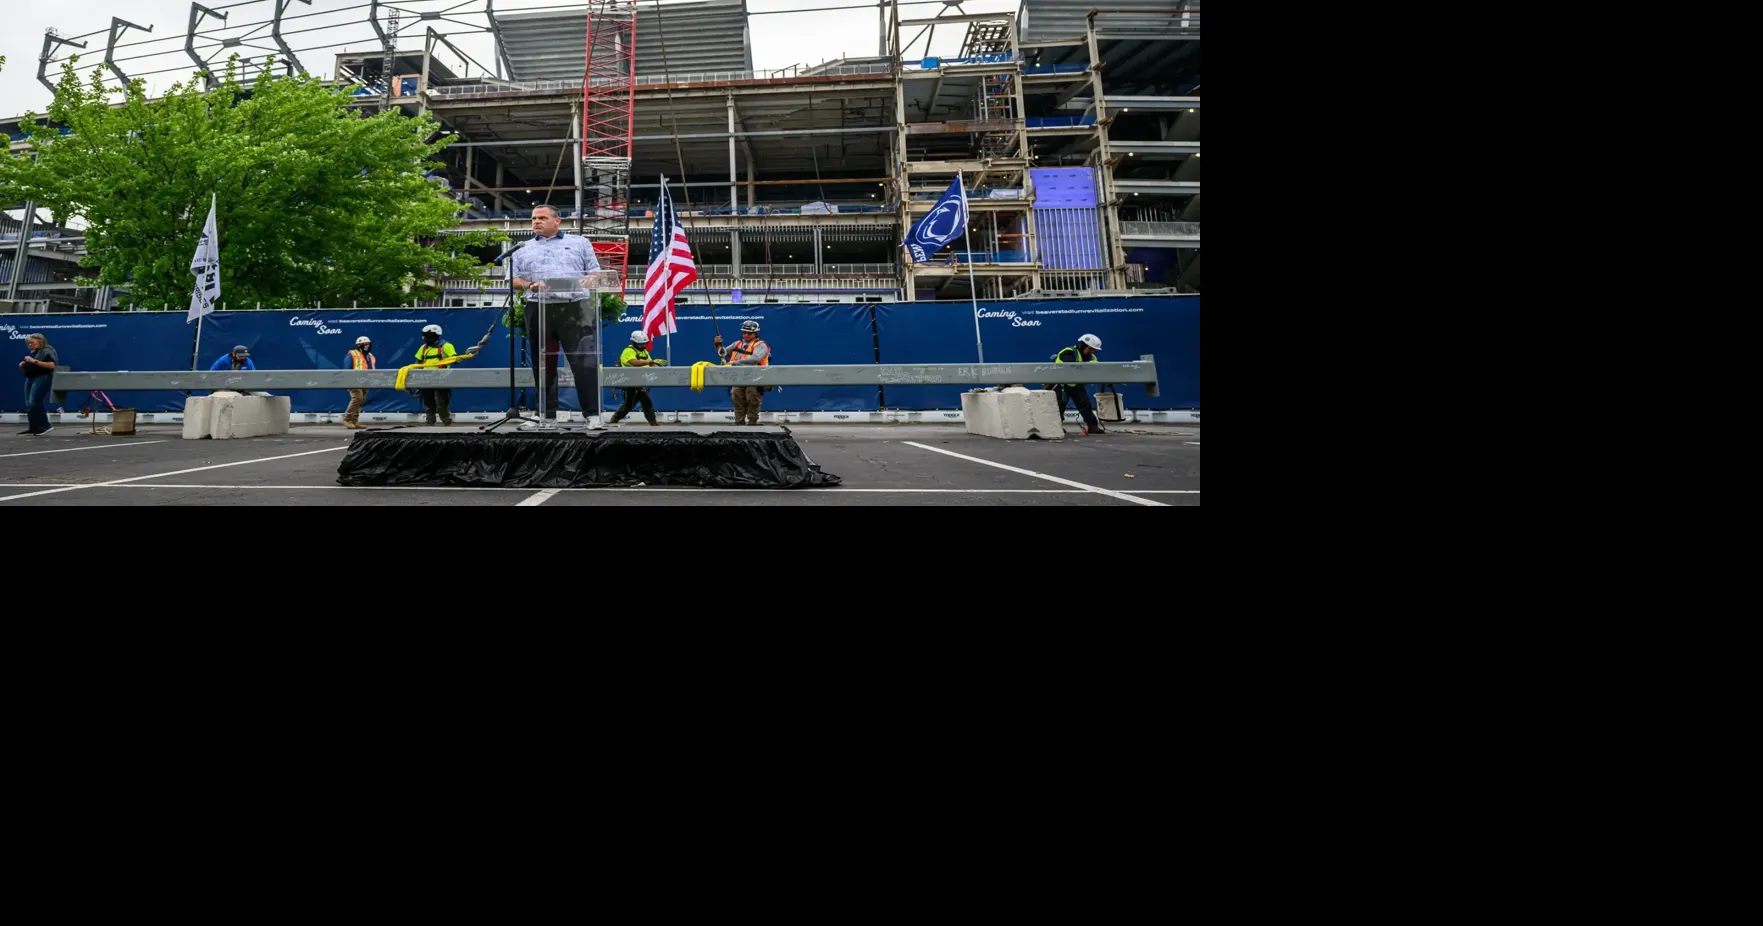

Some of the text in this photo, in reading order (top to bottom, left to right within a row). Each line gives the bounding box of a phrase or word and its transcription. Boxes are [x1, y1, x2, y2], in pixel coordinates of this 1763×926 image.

[618, 313, 644, 323] Comi
[977, 308, 1016, 319] Coming
[290, 317, 323, 328] Coming
[1012, 317, 1041, 327] Soon
[317, 326, 342, 335] Soon
